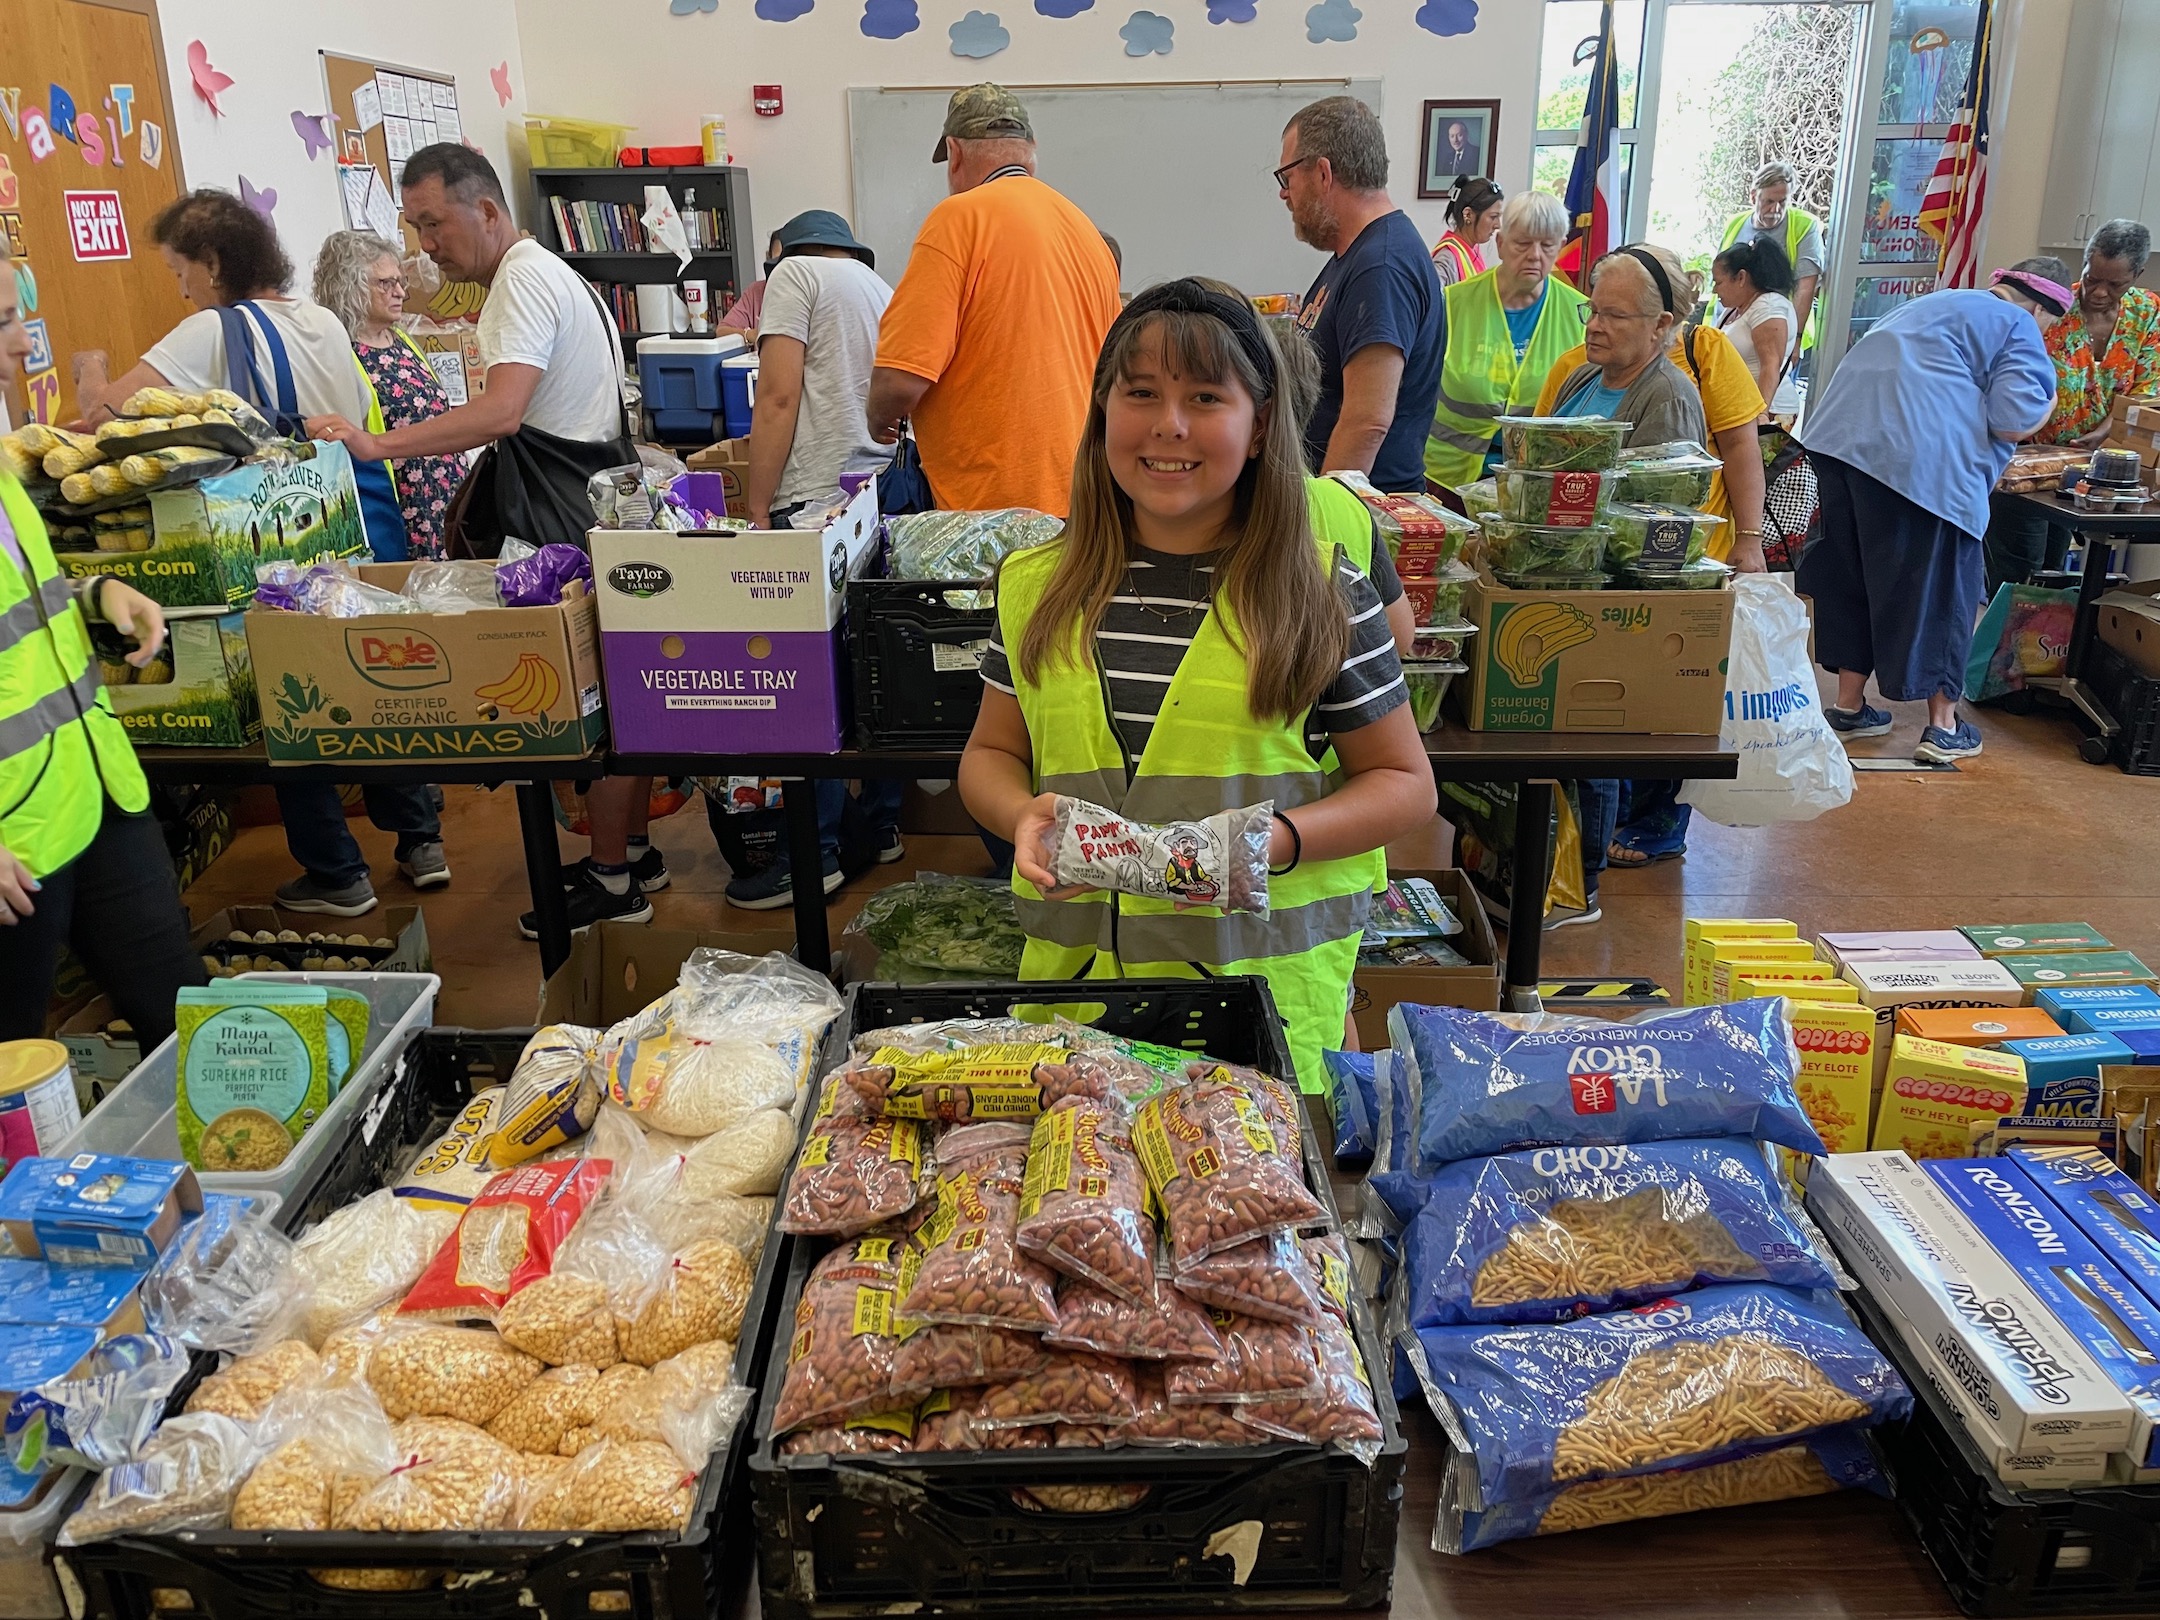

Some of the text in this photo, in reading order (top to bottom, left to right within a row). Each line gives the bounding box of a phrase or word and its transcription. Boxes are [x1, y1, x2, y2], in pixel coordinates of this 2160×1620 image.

[70, 200, 117, 218] NOT AN
[74, 218, 120, 251] EXIT
[686, 290, 698, 300] QT
[289, 466, 324, 495] RIVER
[1566, 482, 1587, 490] TRUE
[1658, 531, 1678, 540] TRUE
[70, 559, 197, 579] Sweet Corn
[616, 567, 664, 584] Taylor
[731, 571, 810, 583] VEGETABLE TRAY
[627, 582, 655, 590] FARMS
[750, 587, 794, 599] WITH DIP
[477, 630, 548, 641] CONSUMER PACK
[361, 636, 437, 666] Dole
[640, 669, 797, 690] VEGETABLE TRAY
[375, 697, 447, 709] CERTIFIED
[759, 698, 772, 706] DIP
[1491, 697, 1550, 711] Bananas
[1724, 690, 1735, 721] 1
[161, 712, 212, 728] Corn
[371, 711, 458, 726] ORGANIC
[1491, 710, 1546, 727] Organic
[316, 729, 524, 756] BANANAS
[1416, 887, 1432, 904] Farm
[1402, 887, 1433, 925] ORGANIC
[1869, 974, 1940, 984] GIOVANNI
[1951, 973, 2001, 982] ELBOWS
[2059, 988, 2142, 999] ORIGINAL
[221, 1026, 269, 1045] Maya
[1523, 1028, 1694, 1047] CHOW MEIN NOODLES
[2026, 1036, 2109, 1051] ORIGINAL
[1566, 1044, 1664, 1075] CHOY
[201, 1067, 288, 1082] SUREKHA RICE
[1824, 1063, 1859, 1074] ELOTE
[225, 1084, 264, 1092] PERFECTLY
[233, 1092, 256, 1101] PLAIN
[2047, 1079, 2092, 1098] HILL COUNTRY
[974, 1094, 1037, 1104] KIDNEY BEANS
[983, 1103, 1031, 1112] DRIED RED
[1900, 1105, 1954, 1121] HEY HEY
[2034, 1100, 2091, 1118] MAC
[2010, 1118, 2060, 1127] HOLIDAY
[2062, 1119, 2100, 1128] VALUE
[1195, 1151, 1211, 1173] USA
[1532, 1144, 1629, 1178] CHOY
[529, 1171, 558, 1197] LONG
[1505, 1182, 1553, 1206] CHOW
[1855, 1174, 1942, 1262] SPAGHETTI
[1963, 1167, 2066, 1255] RONZONI
[1843, 1215, 1892, 1283] SPAGHETTI
[2101, 1222, 2160, 1279] Spaghetti
[2080, 1262, 2142, 1322] Spaghetti
[1944, 1280, 2071, 1405] GIOVANNI
[1982, 1299, 2075, 1382] PRIMO
[1949, 1336, 1993, 1396] PRIMO
[1935, 1333, 2001, 1421] GIOVANNI
